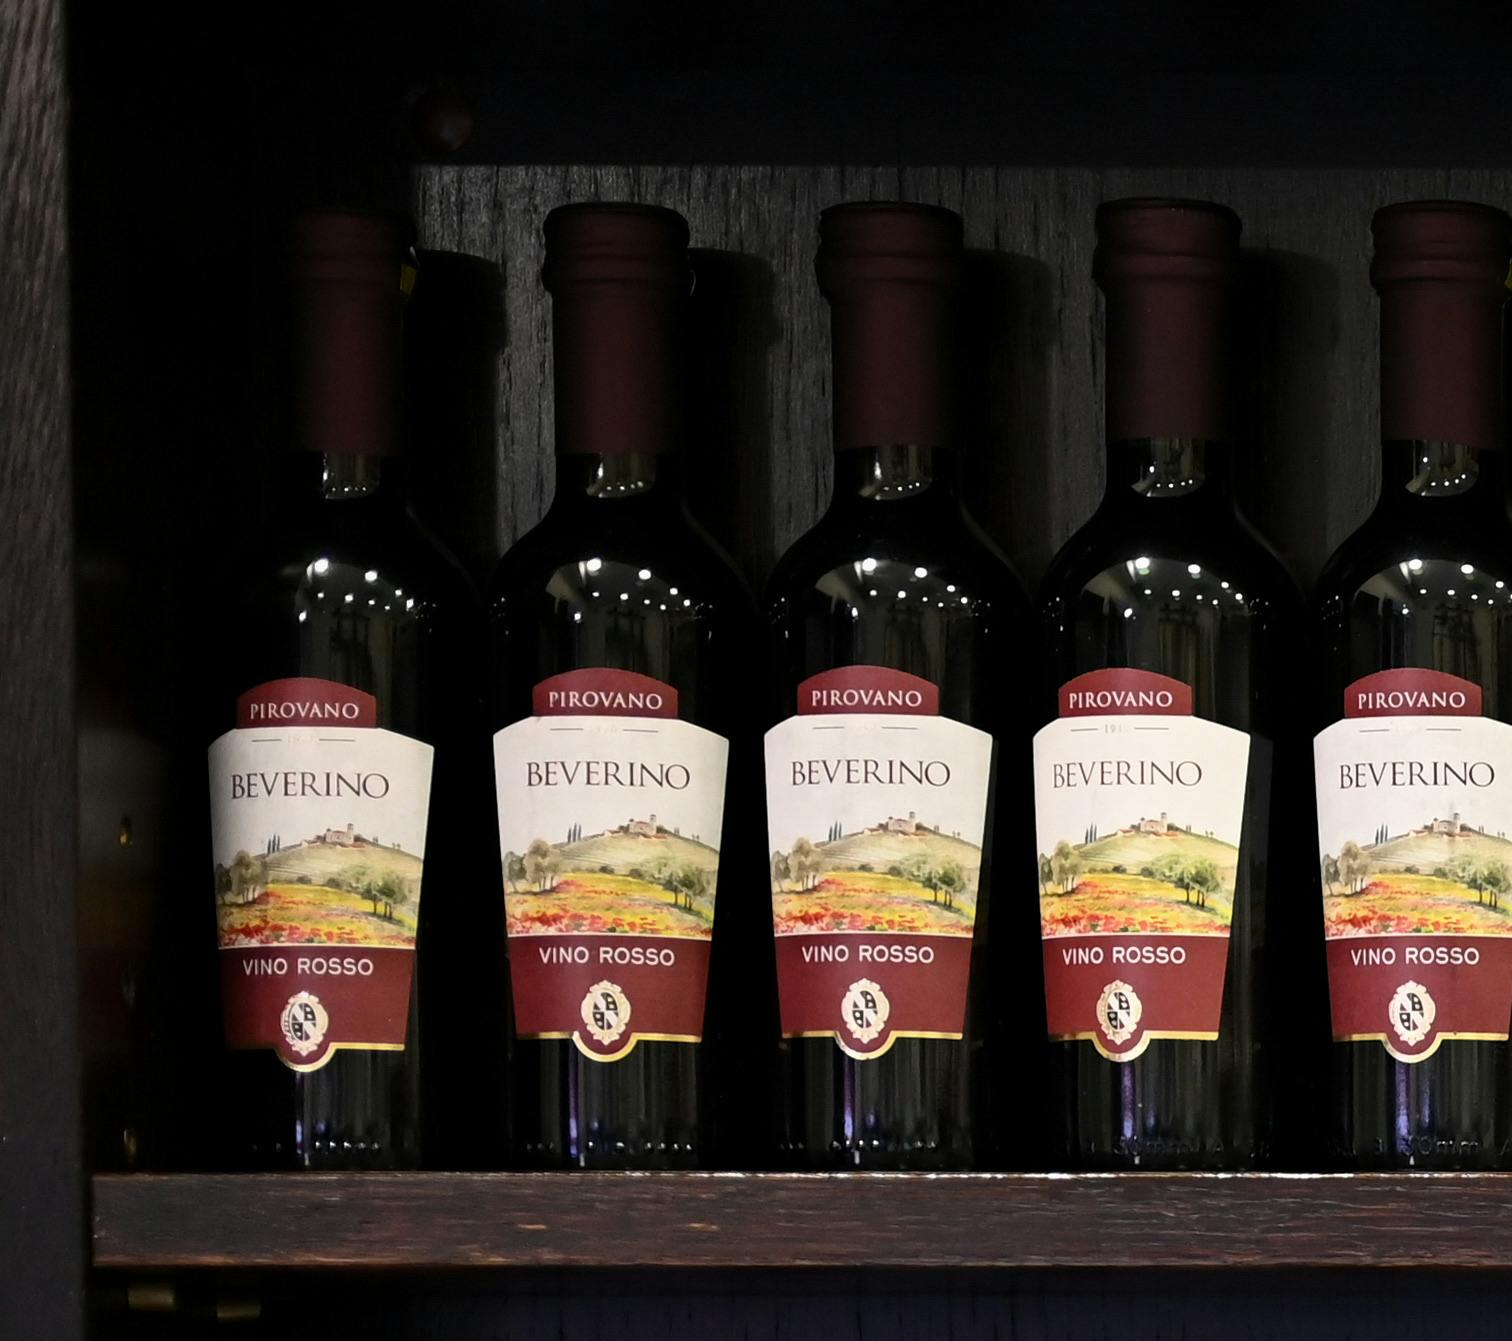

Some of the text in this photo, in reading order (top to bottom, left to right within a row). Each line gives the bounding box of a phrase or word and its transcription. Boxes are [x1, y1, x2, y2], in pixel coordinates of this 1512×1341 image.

[1068, 691, 1173, 709] PIROVANO
[249, 701, 360, 721] PIROVANO
[1052, 760, 1203, 789] BEVERINO
[231, 771, 390, 800] BEVERINO
[1063, 948, 1186, 965] VINO ROSSO
[242, 959, 374, 975] VINO ROSSO
